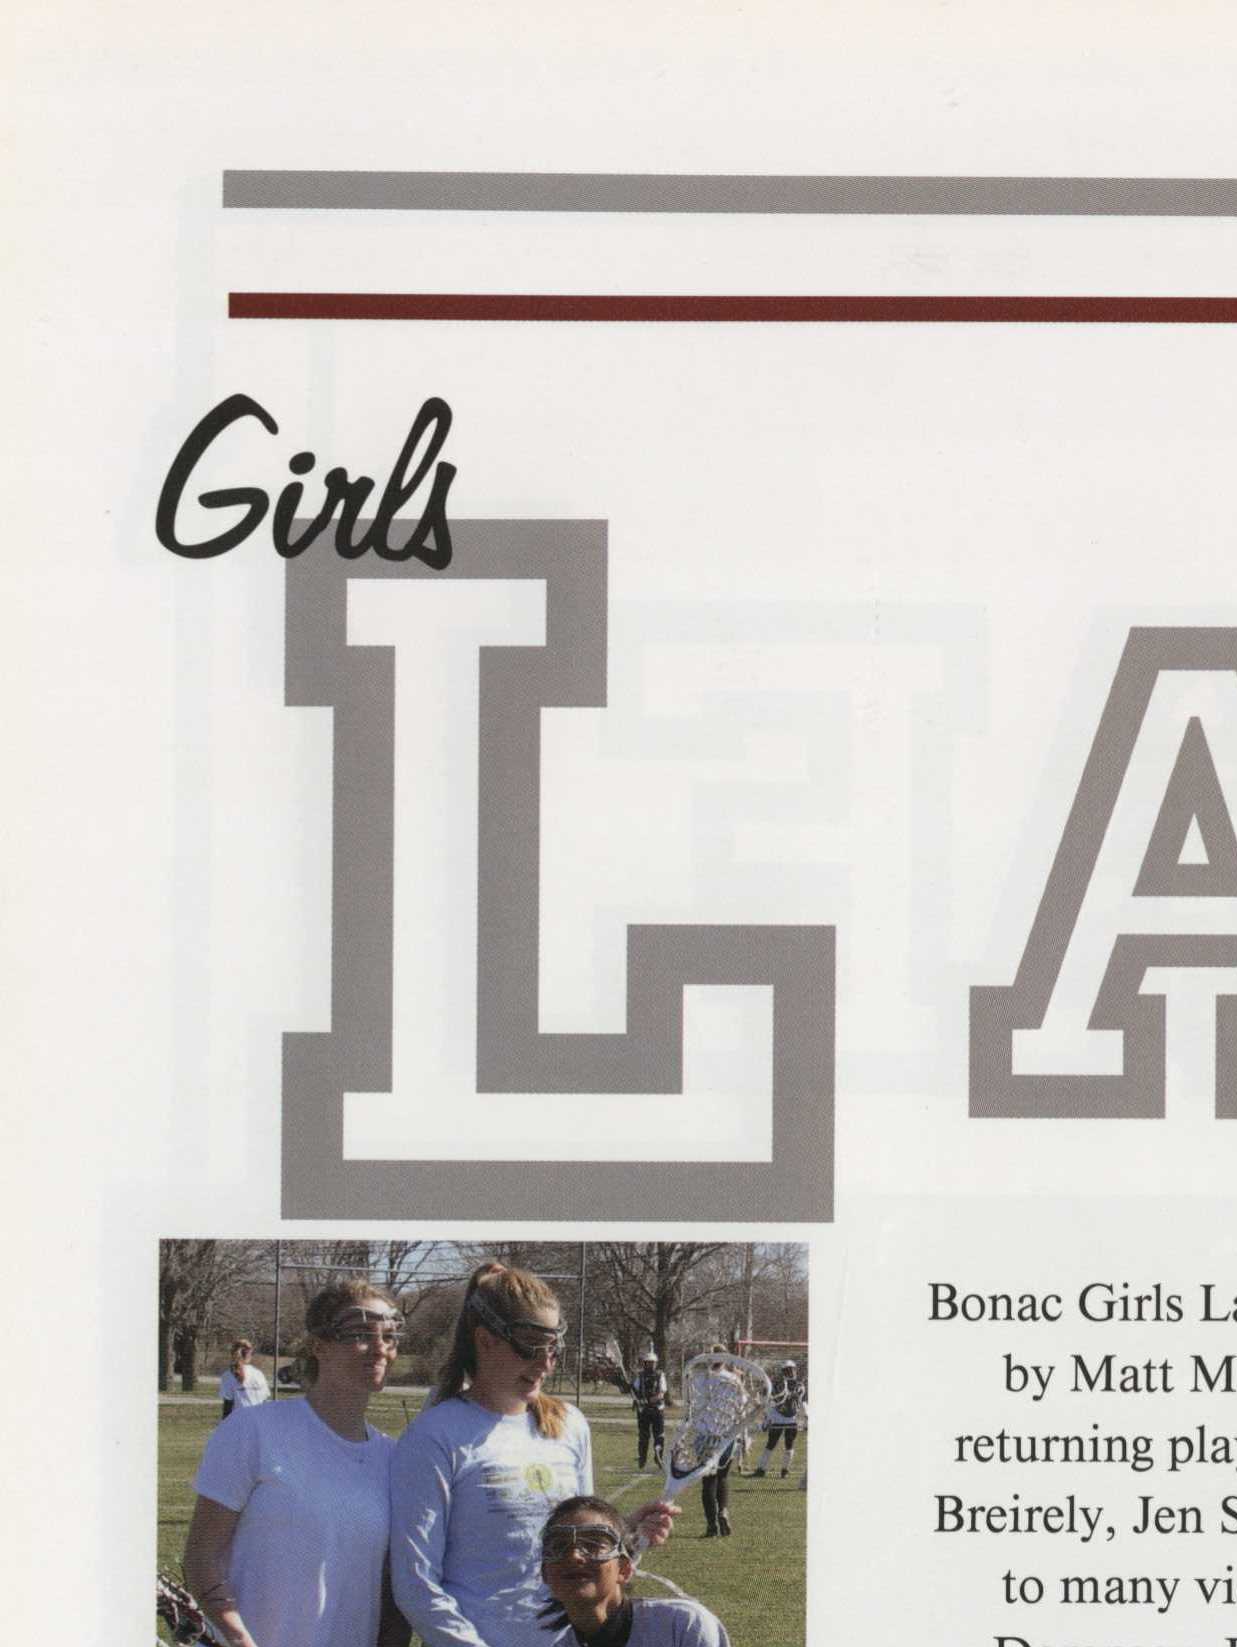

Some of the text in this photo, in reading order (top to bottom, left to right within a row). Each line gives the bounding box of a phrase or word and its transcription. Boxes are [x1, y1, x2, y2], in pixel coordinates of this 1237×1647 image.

[156, 393, 457, 571] Girls
[928, 1283, 1062, 1322] Bonac
[1078, 1282, 1184, 1323] Girls
[1002, 1353, 1055, 1402] by
[1070, 1354, 1175, 1393] Matt
[955, 1423, 1154, 1473] returning
[934, 1493, 1115, 1543] Breirely,
[1132, 1495, 1204, 1535] Jen
[1001, 1569, 1044, 1604] to
[1060, 1576, 1181, 1614] many
